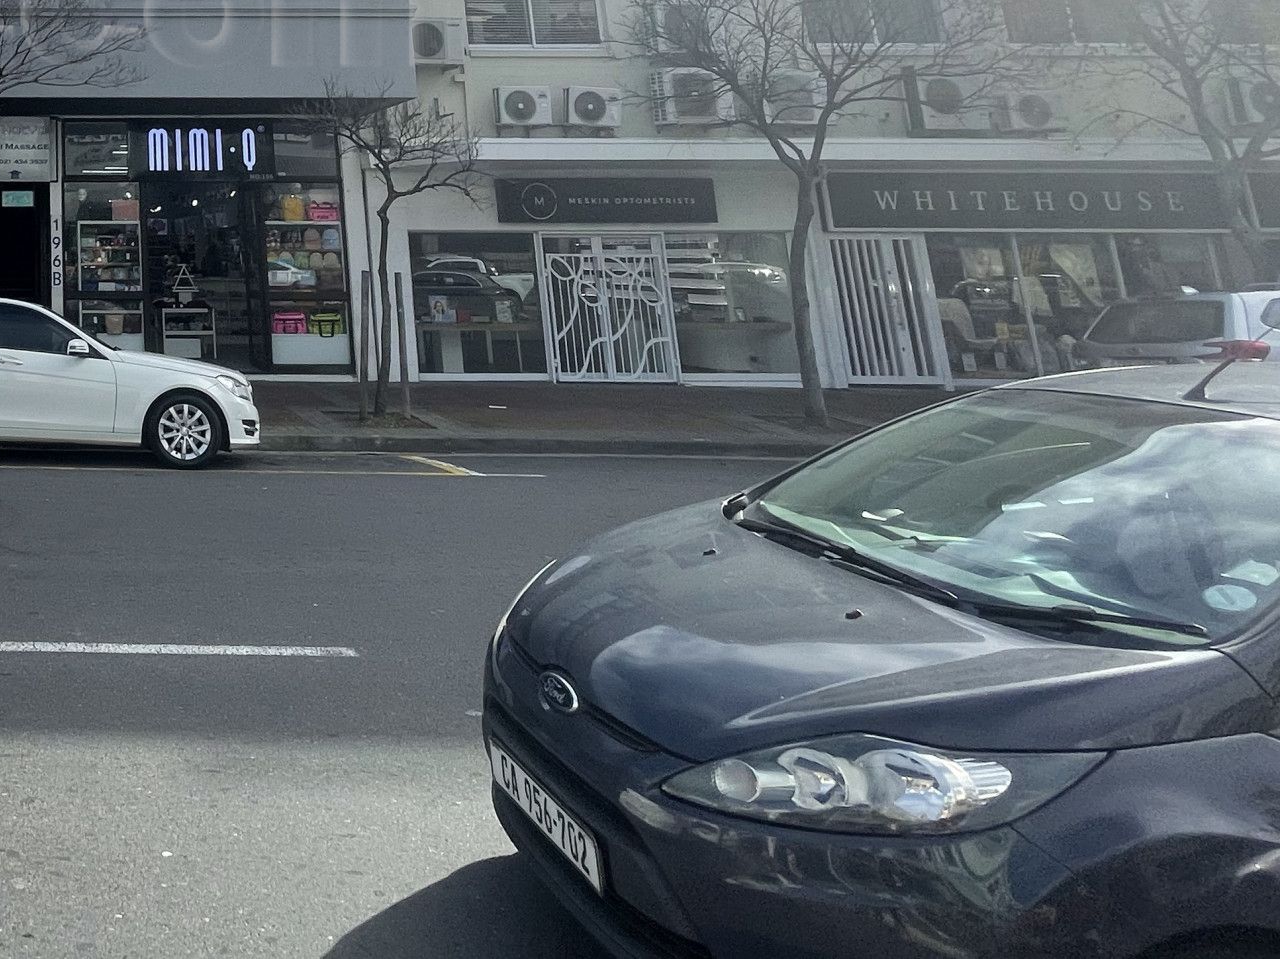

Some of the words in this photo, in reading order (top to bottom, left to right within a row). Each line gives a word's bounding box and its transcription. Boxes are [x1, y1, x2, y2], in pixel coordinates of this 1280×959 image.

[614, 197, 696, 205] OPTOMETRISTS
[873, 190, 1185, 212] WHITEHOUSE
[52, 218, 62, 286] 196B
[501, 754, 520, 801] CA
[524, 781, 591, 877] 956-702
